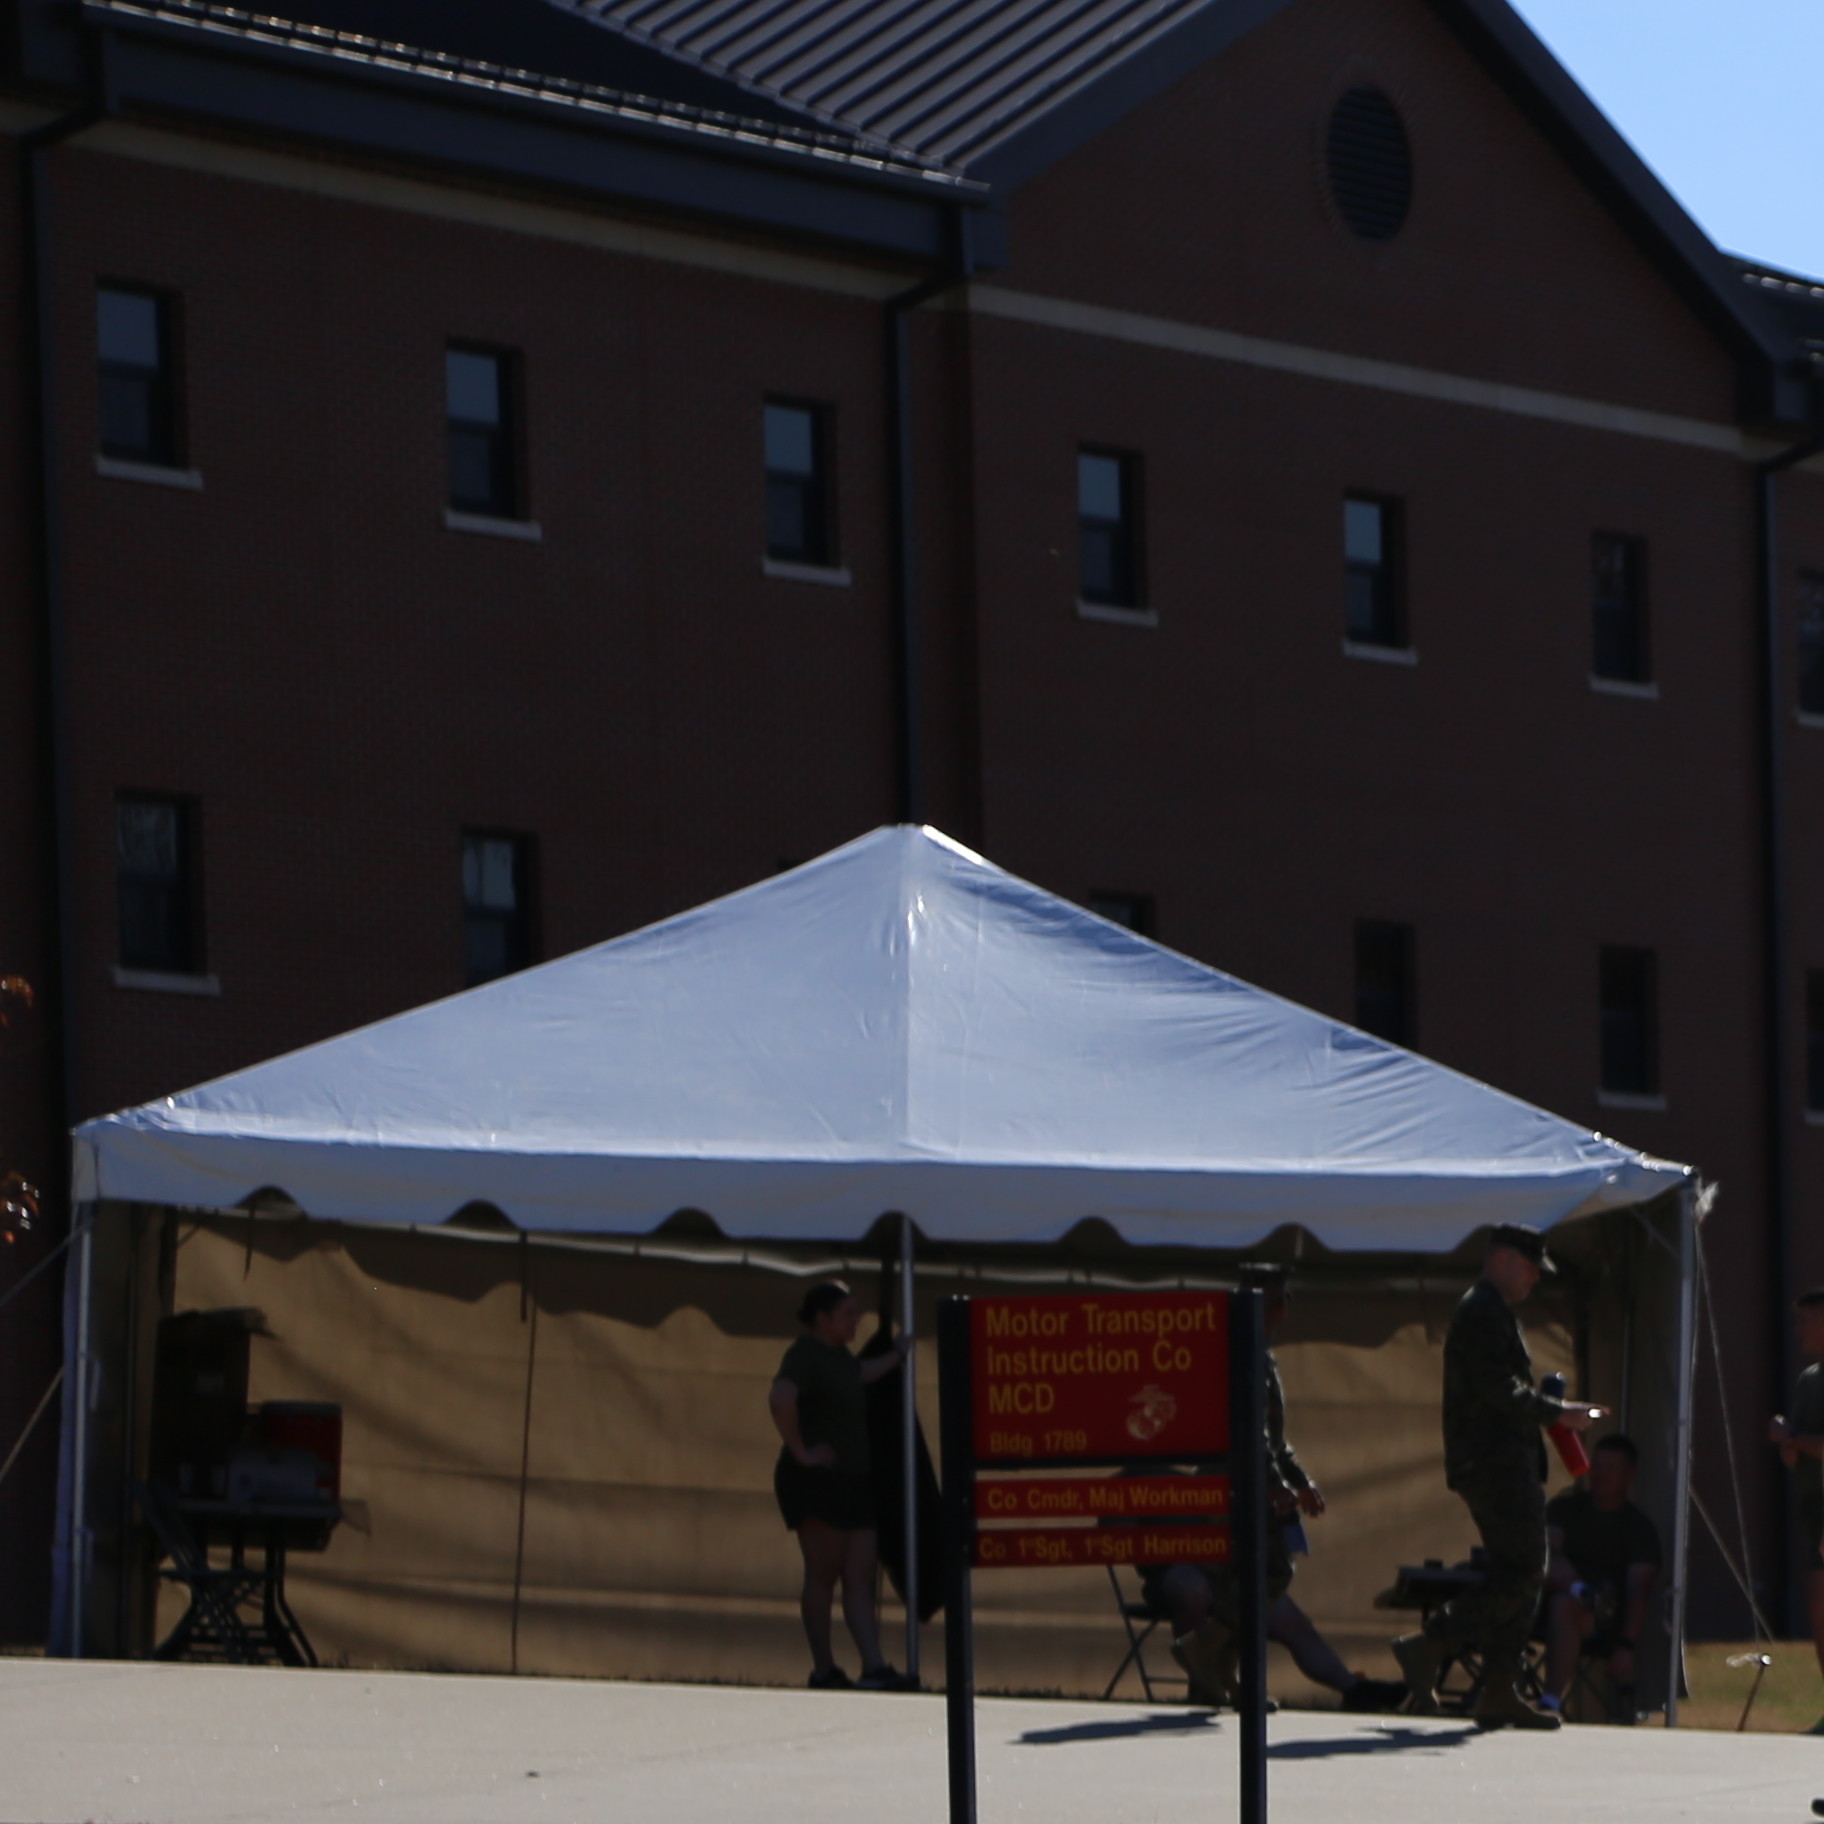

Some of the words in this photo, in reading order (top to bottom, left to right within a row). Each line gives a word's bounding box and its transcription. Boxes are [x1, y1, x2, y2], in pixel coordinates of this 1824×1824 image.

[985, 1305, 1070, 1338] Motor
[1081, 1301, 1217, 1338] Transport
[987, 1342, 1140, 1376] Instruction
[1152, 1339, 1193, 1373] Co
[988, 1382, 1056, 1415] MCD
[990, 1431, 1033, 1457] Bldg
[1044, 1429, 1089, 1453] 1789
[987, 1487, 1017, 1511] Co
[1027, 1487, 1084, 1512] Cmdr,
[1089, 1486, 1125, 1512] Maj
[1129, 1485, 1224, 1509] Workman
[979, 1535, 1006, 1560] Co
[1144, 1533, 1227, 1556] Harrison
